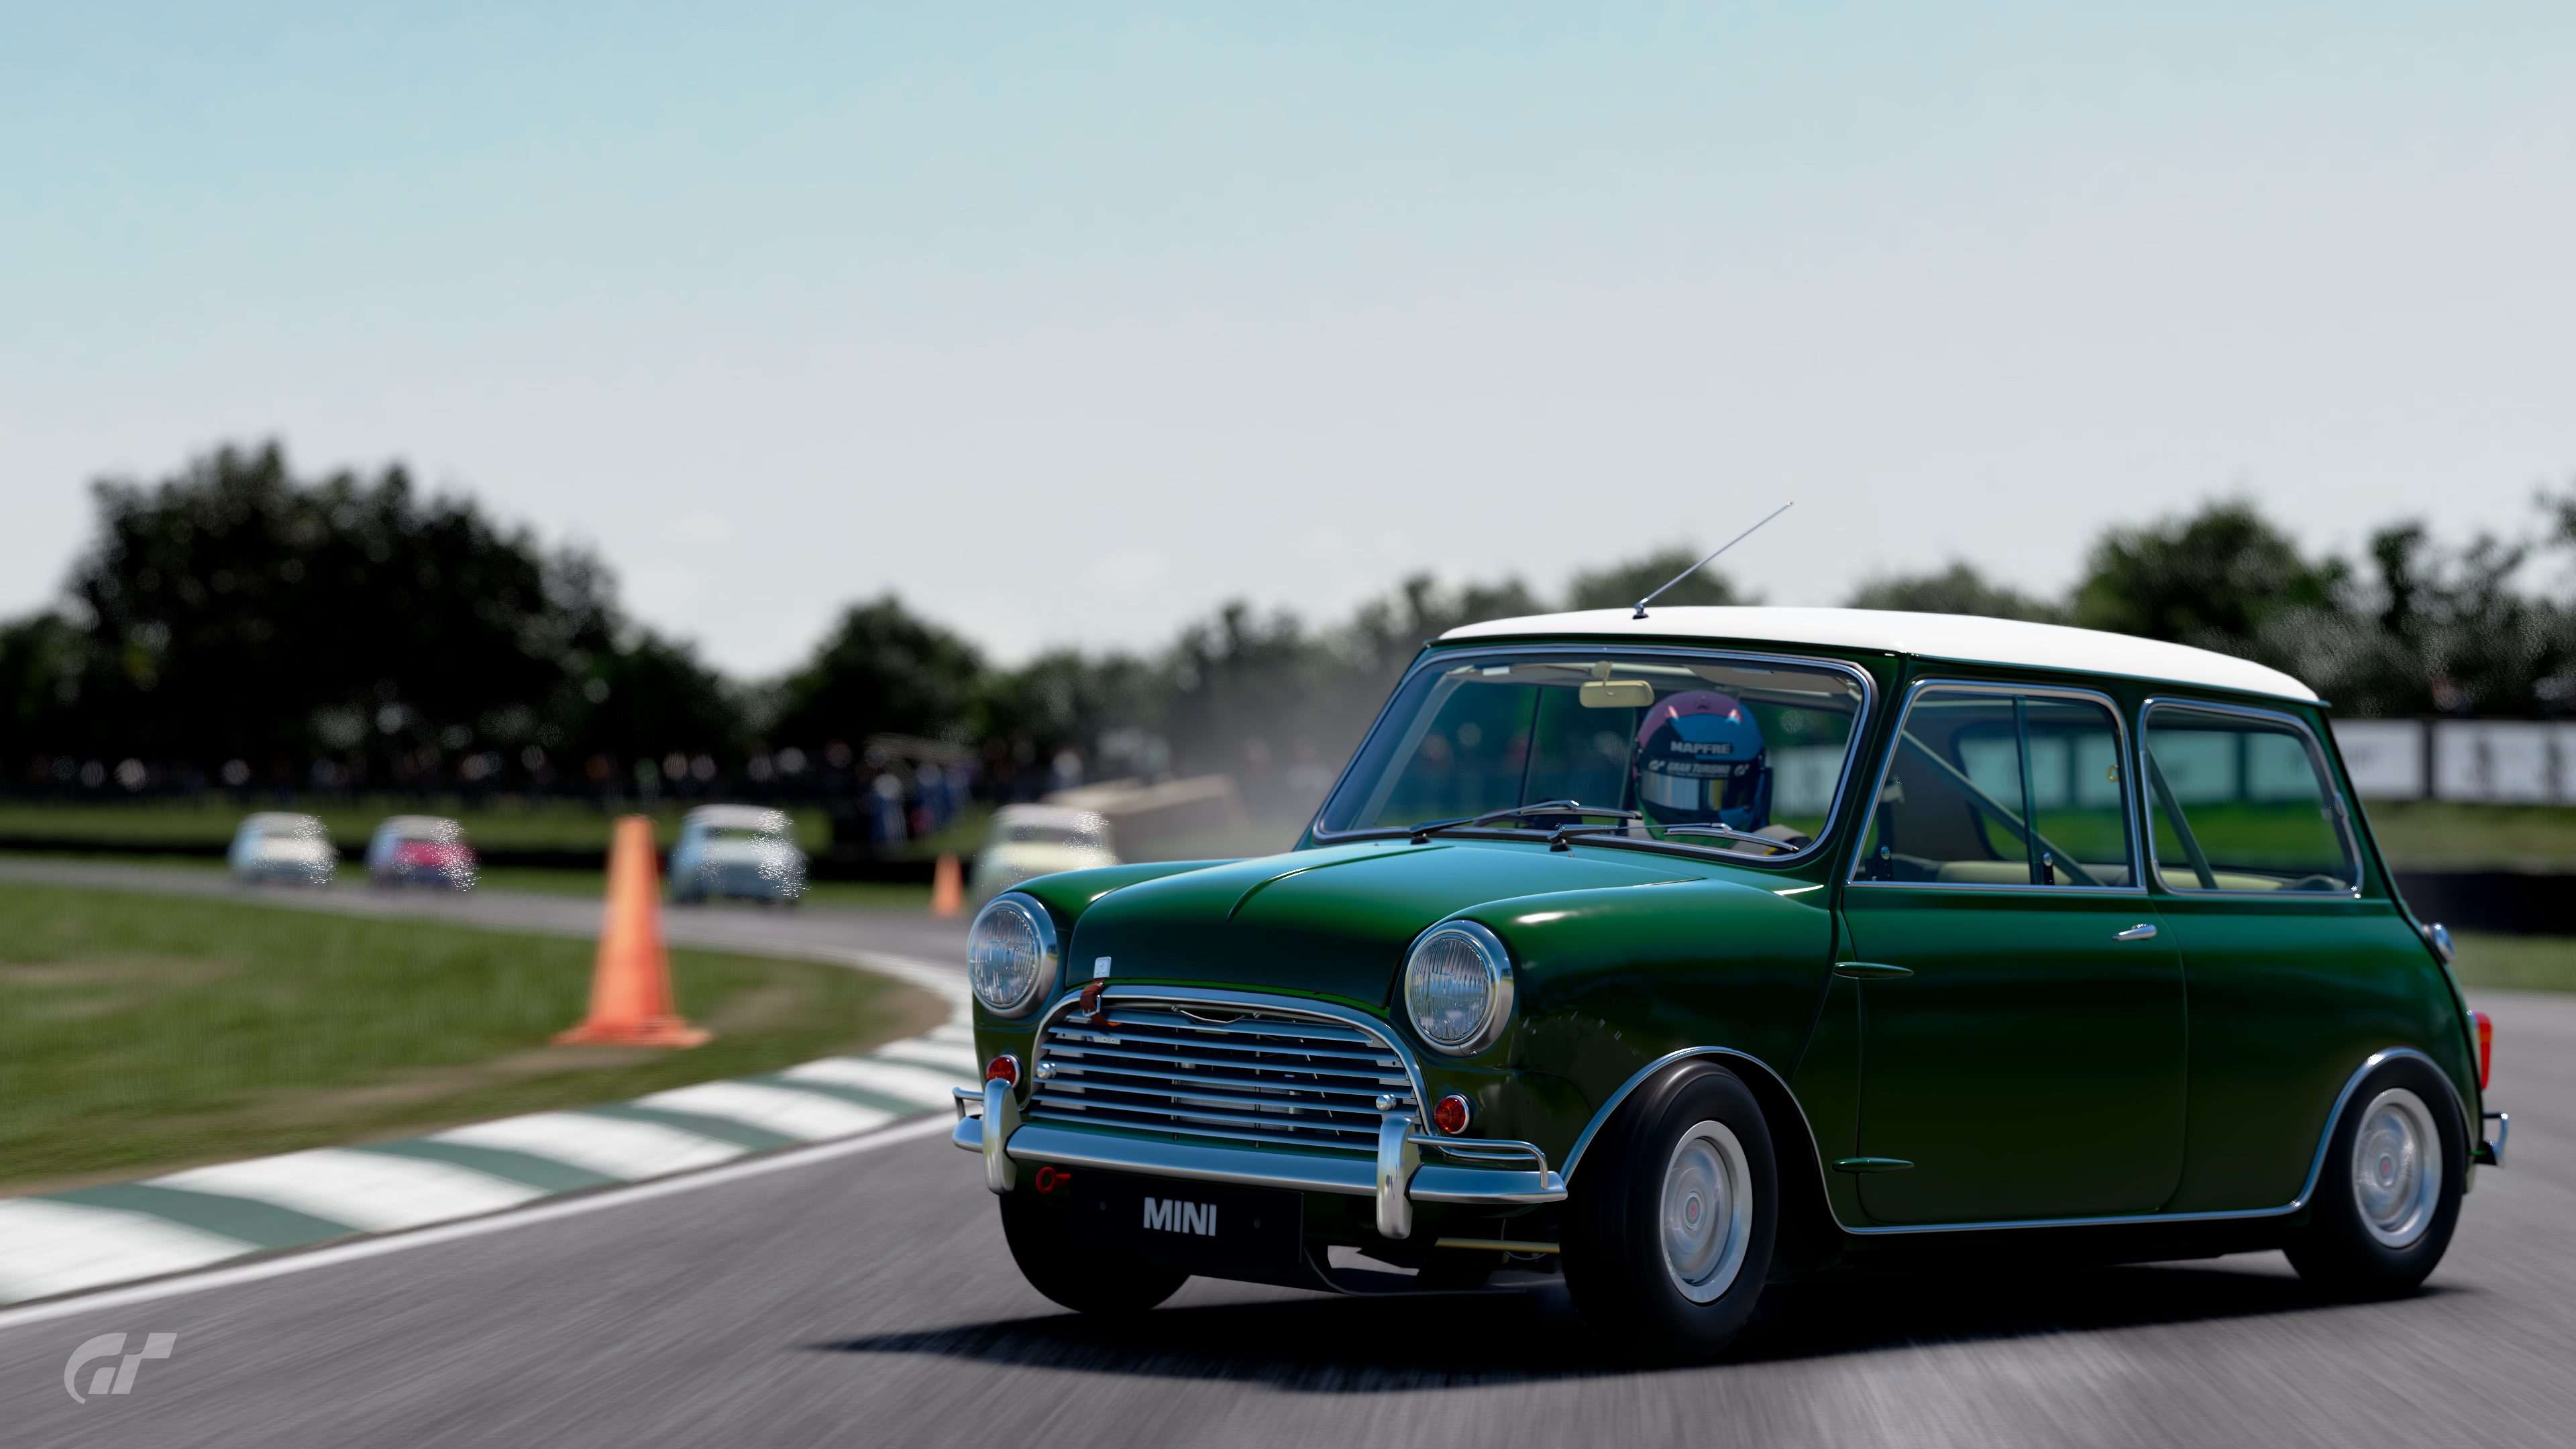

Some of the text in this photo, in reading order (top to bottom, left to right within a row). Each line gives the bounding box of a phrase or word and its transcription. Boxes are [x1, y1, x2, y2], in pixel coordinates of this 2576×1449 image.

[1670, 741, 1731, 754] MAPFRE
[1666, 761, 1691, 772] GRAN
[1693, 763, 1731, 773] TURISMO
[1143, 1197, 1217, 1236] MINI
